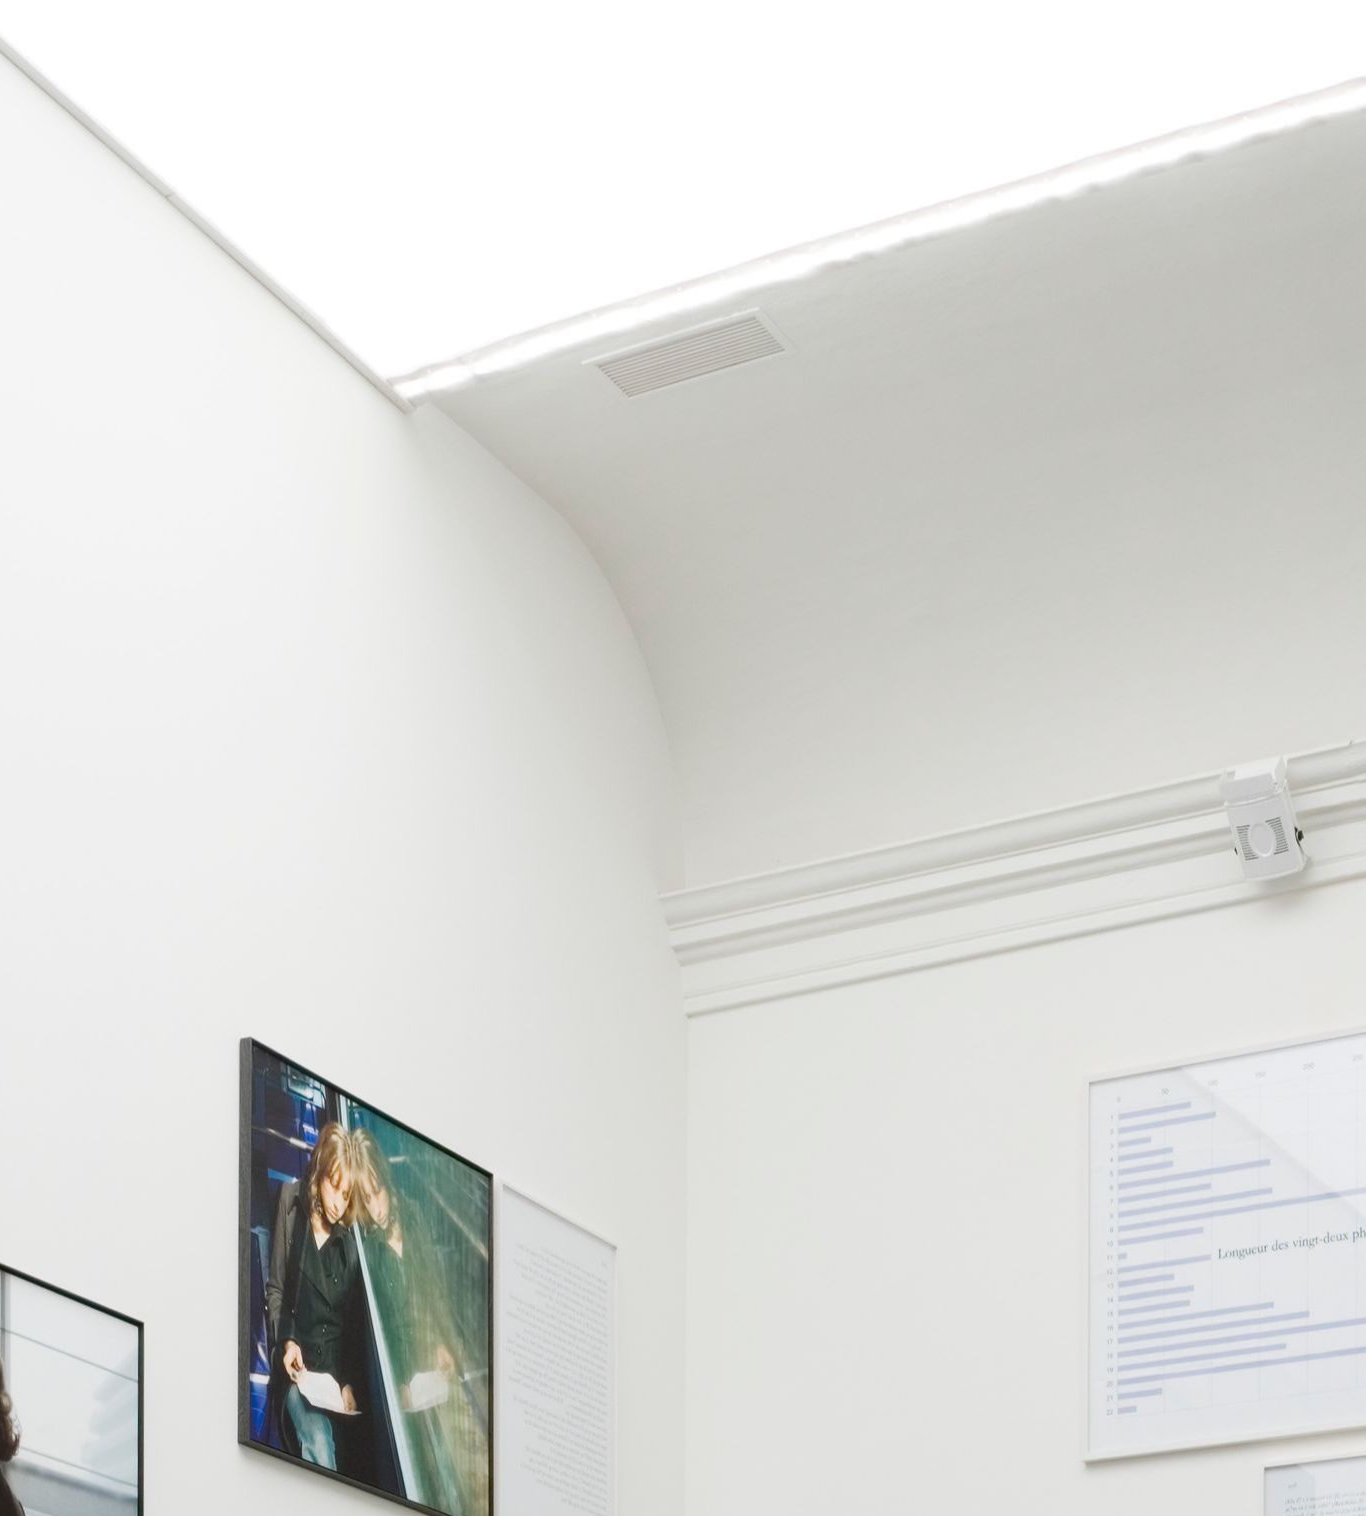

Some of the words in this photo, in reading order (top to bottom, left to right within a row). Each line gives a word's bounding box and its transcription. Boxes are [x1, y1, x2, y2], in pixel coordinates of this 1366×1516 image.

[1218, 1244, 1268, 1260] Longueur
[1271, 1239, 1289, 1252] des
[1292, 1232, 1349, 1249] vingt-deux
